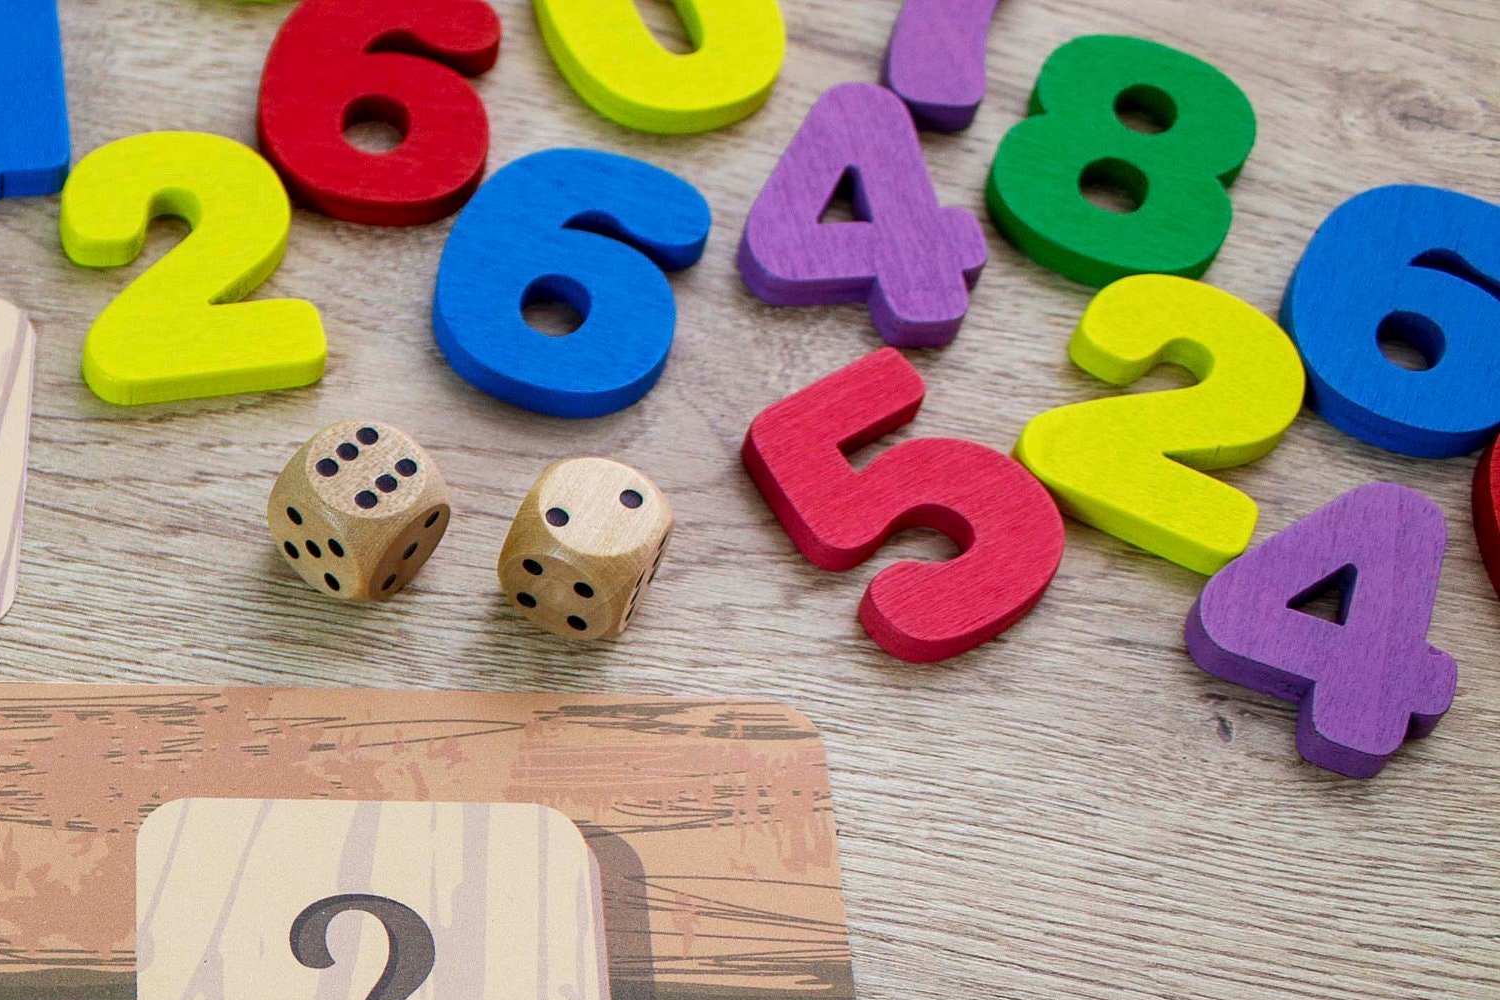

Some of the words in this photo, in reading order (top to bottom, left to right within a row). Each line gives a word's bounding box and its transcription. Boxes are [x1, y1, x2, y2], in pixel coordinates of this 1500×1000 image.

[258, 0, 500, 226] 6
[738, 82, 988, 348] 4
[985, 34, 1258, 290] 8
[59, 130, 328, 406] 2
[431, 147, 713, 419] 6
[1279, 184, 1500, 458] 6
[741, 346, 1066, 664] 5
[1013, 272, 1307, 577] 2
[1185, 481, 1459, 780] 4
